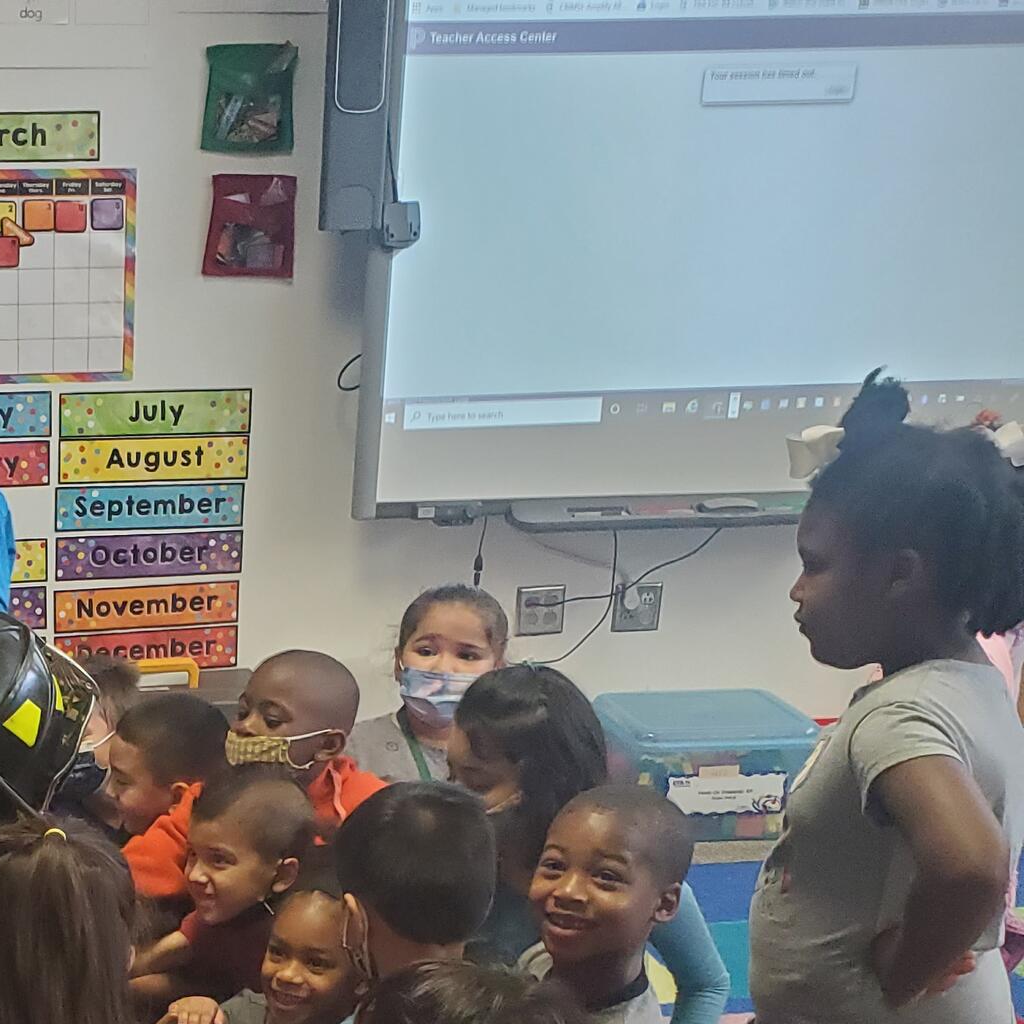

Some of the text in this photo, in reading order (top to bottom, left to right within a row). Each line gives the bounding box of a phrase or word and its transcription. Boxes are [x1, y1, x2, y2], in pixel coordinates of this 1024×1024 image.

[19, 7, 43, 22] dog
[429, 29, 557, 45] Teacher Access Center
[128, 400, 185, 426] July
[427, 410, 504, 423] Type here to search
[105, 445, 205, 473] August
[74, 493, 227, 521] September
[90, 542, 209, 567] October
[77, 593, 219, 619] November
